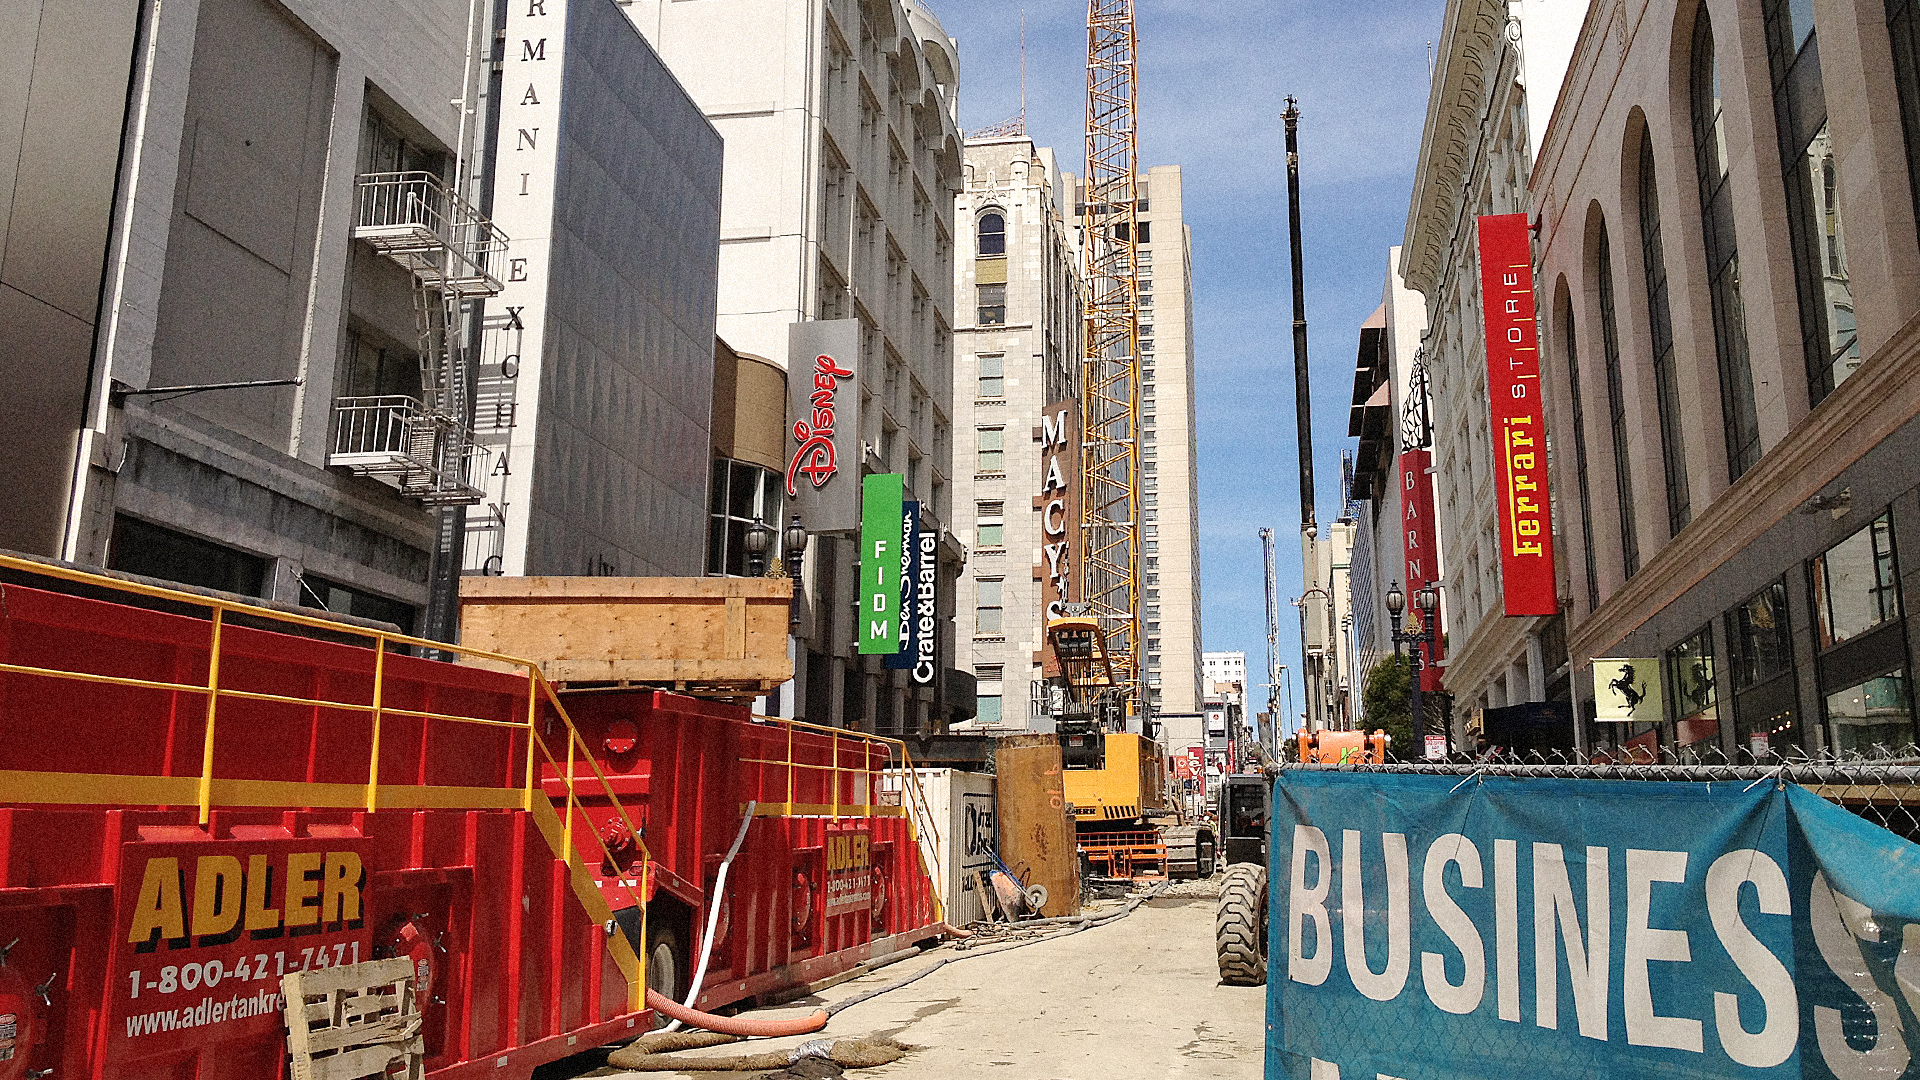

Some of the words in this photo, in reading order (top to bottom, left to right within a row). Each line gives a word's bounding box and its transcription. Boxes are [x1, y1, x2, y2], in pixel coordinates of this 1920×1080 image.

[1503, 272, 1527, 399] STORE
[787, 355, 853, 496] Disney
[1504, 415, 1543, 557] Ferrari
[870, 540, 888, 640] FIDM
[912, 532, 936, 683] Crate&Barrel
[128, 851, 366, 950] ADLER
[827, 835, 870, 871] ADLER
[128, 941, 360, 998] 1-800-421-7471
[1288, 823, 1920, 1080] BUSINESS
